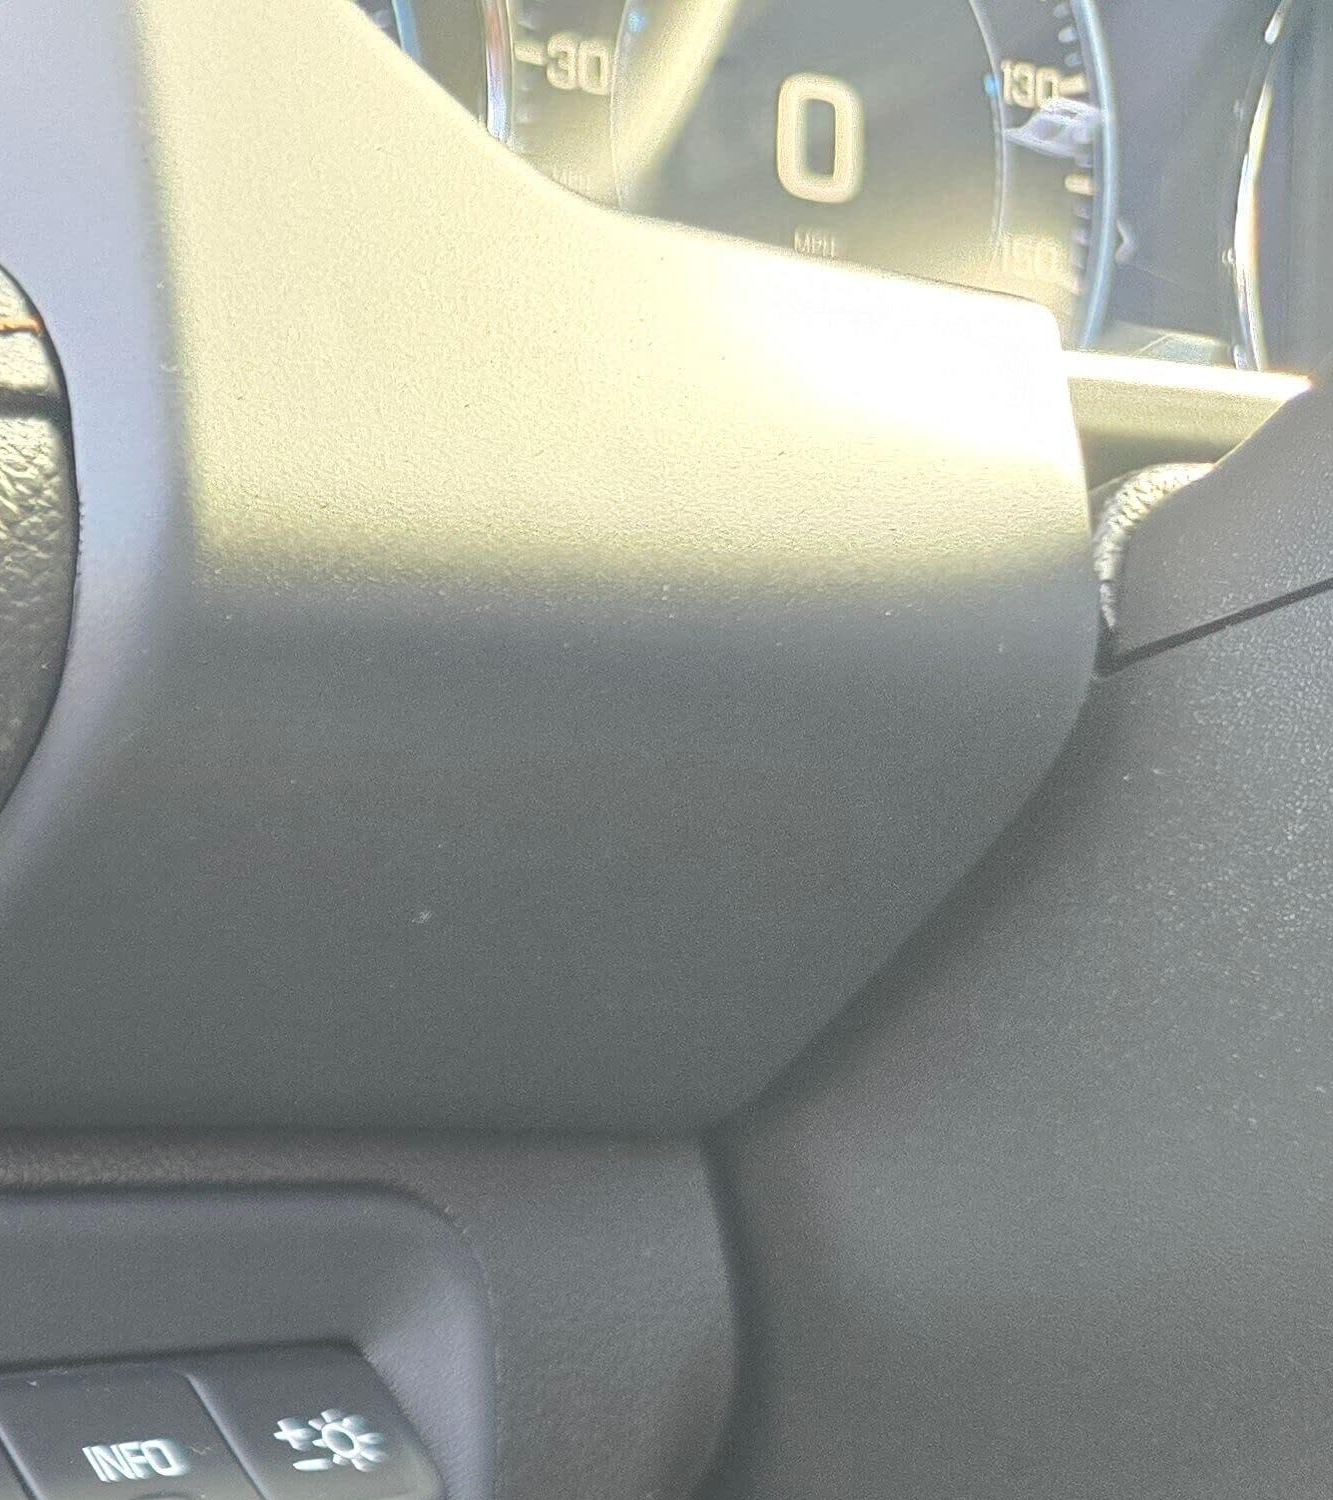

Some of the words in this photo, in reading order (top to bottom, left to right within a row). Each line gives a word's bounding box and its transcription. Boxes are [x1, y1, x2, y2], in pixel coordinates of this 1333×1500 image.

[546, 33, 610, 95] 30
[1000, 59, 1061, 111] 130
[776, 72, 865, 203] 0
[82, 1439, 189, 1483] INFO
